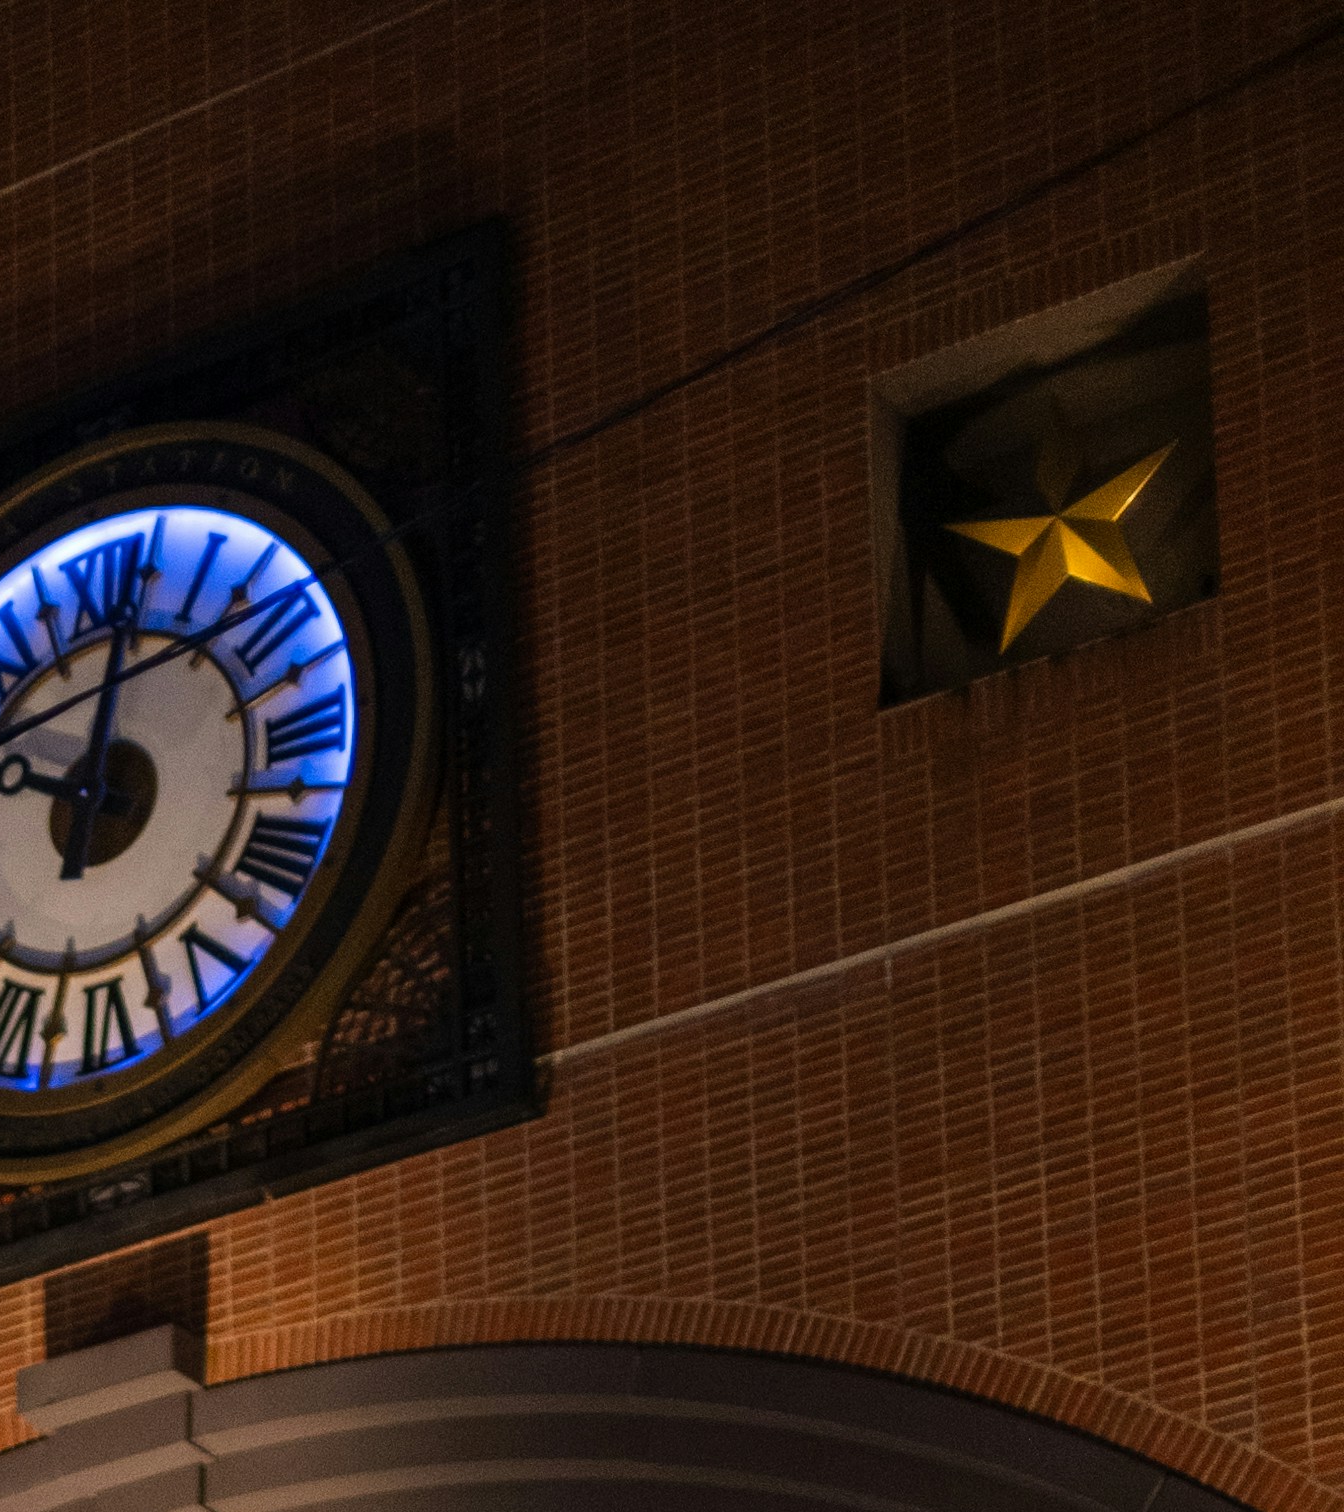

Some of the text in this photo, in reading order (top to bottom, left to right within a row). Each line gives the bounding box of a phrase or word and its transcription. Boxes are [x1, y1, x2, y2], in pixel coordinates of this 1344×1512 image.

[67, 448, 300, 500] STATION
[177, 533, 227, 622] I
[267, 684, 347, 763] III
[181, 924, 257, 1016] V
[78, 977, 143, 1076] VI
